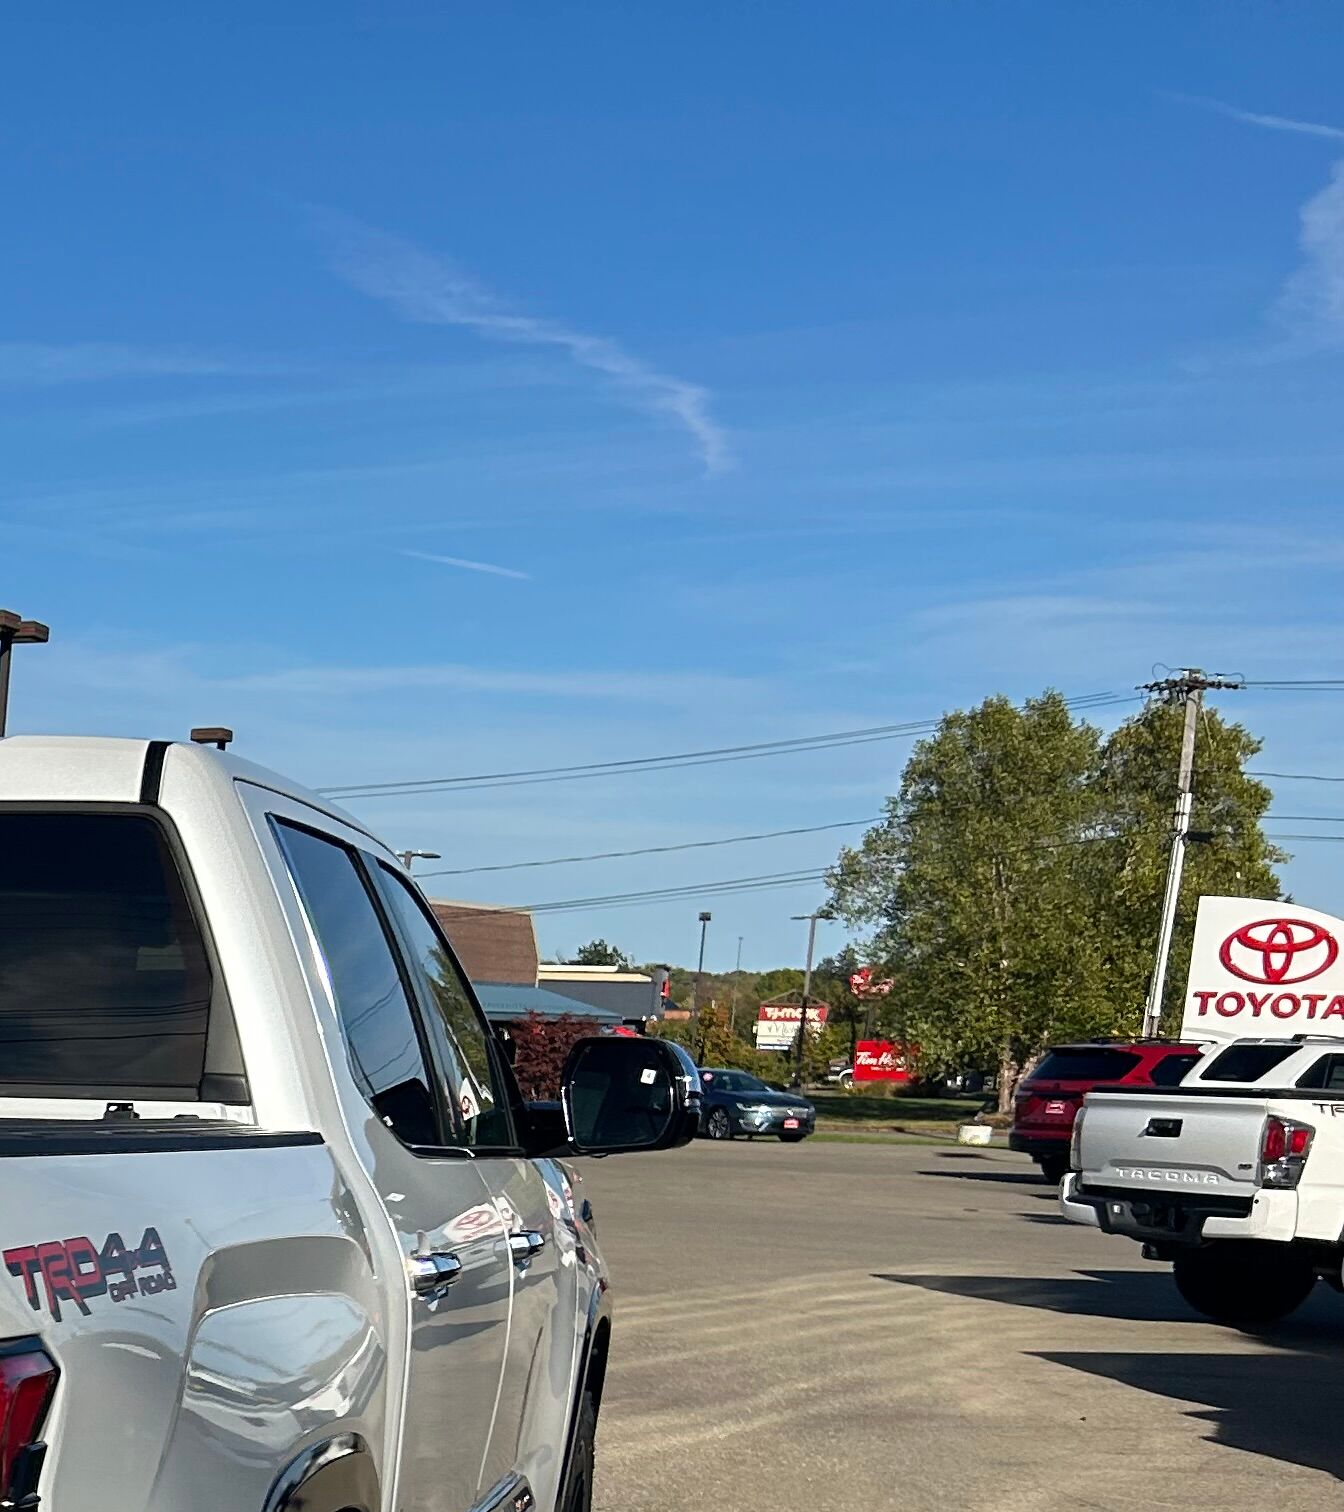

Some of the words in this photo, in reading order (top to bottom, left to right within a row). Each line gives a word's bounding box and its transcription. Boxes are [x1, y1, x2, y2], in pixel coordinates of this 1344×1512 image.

[1193, 991, 1344, 1019] TOYOTA
[1115, 1167, 1221, 1185] TACOMA
[2, 1236, 108, 1322] TRD
[137, 1271, 177, 1297] ROAD
